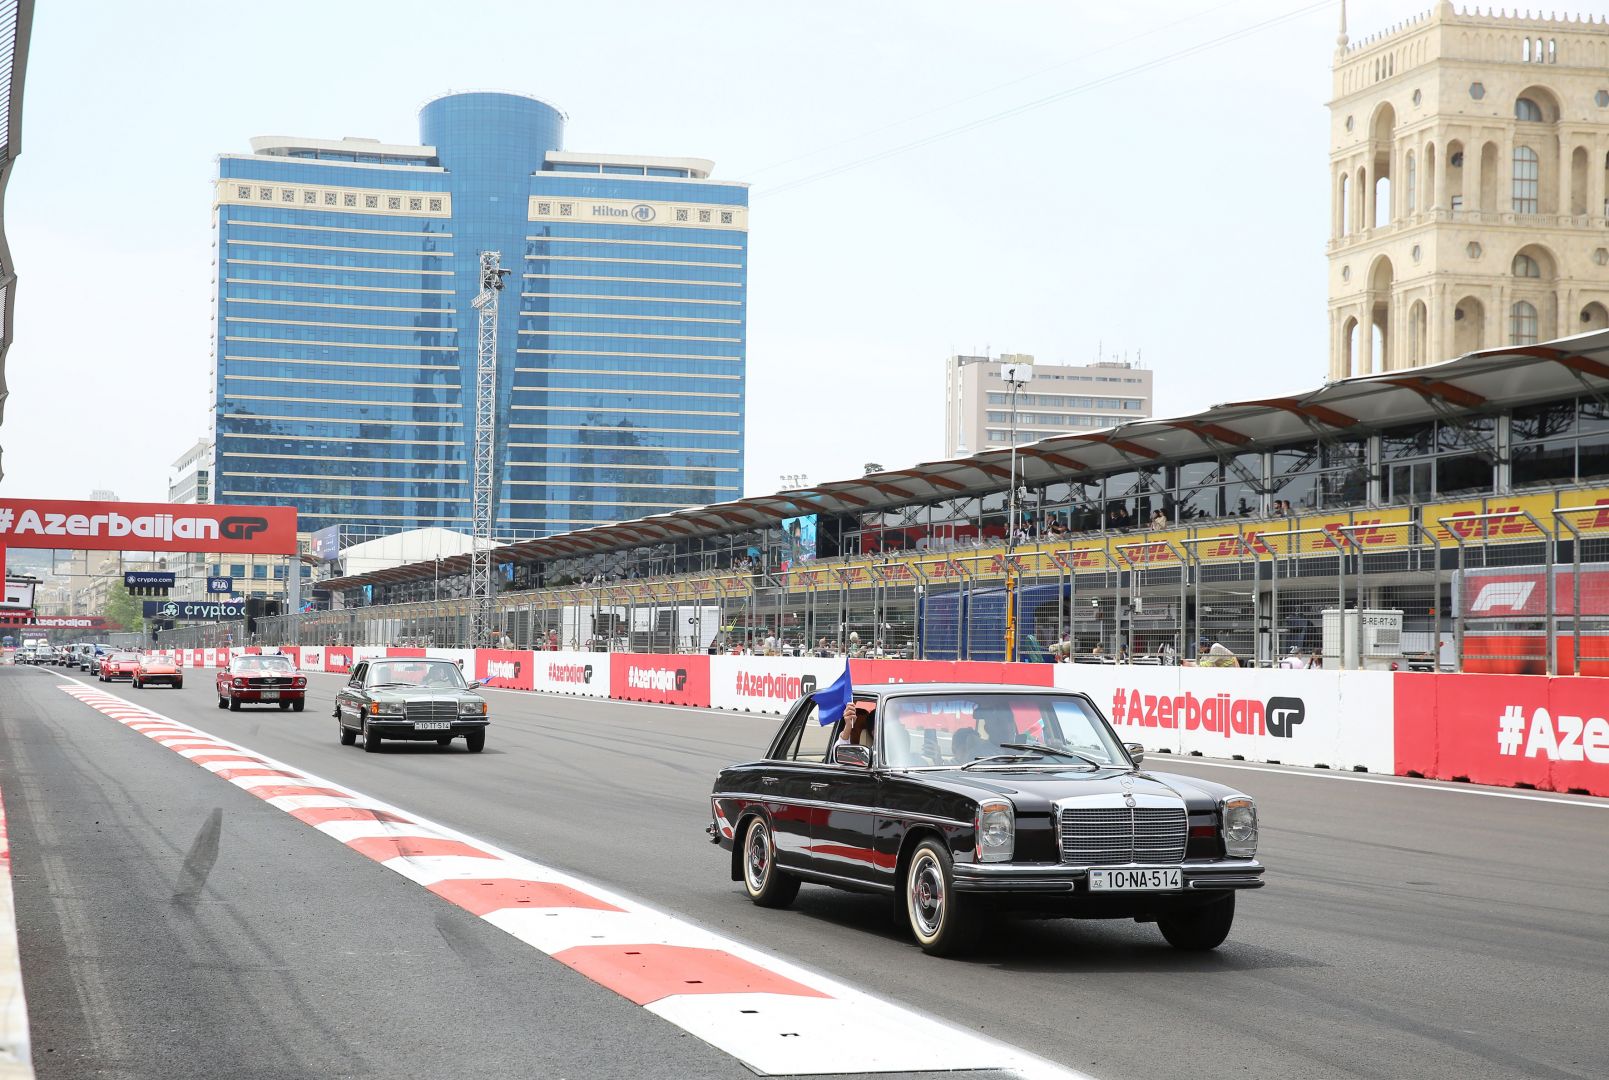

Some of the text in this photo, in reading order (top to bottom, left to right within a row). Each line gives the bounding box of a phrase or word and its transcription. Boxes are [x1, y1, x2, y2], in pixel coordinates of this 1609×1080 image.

[592, 205, 628, 217] Hilton
[1451, 506, 1525, 538] DHL
[136, 576, 173, 584] crypto.com
[211, 580, 227, 589] FIA
[1497, 705, 1609, 764] #Aze
[1107, 870, 1179, 888] 10-NA-514
